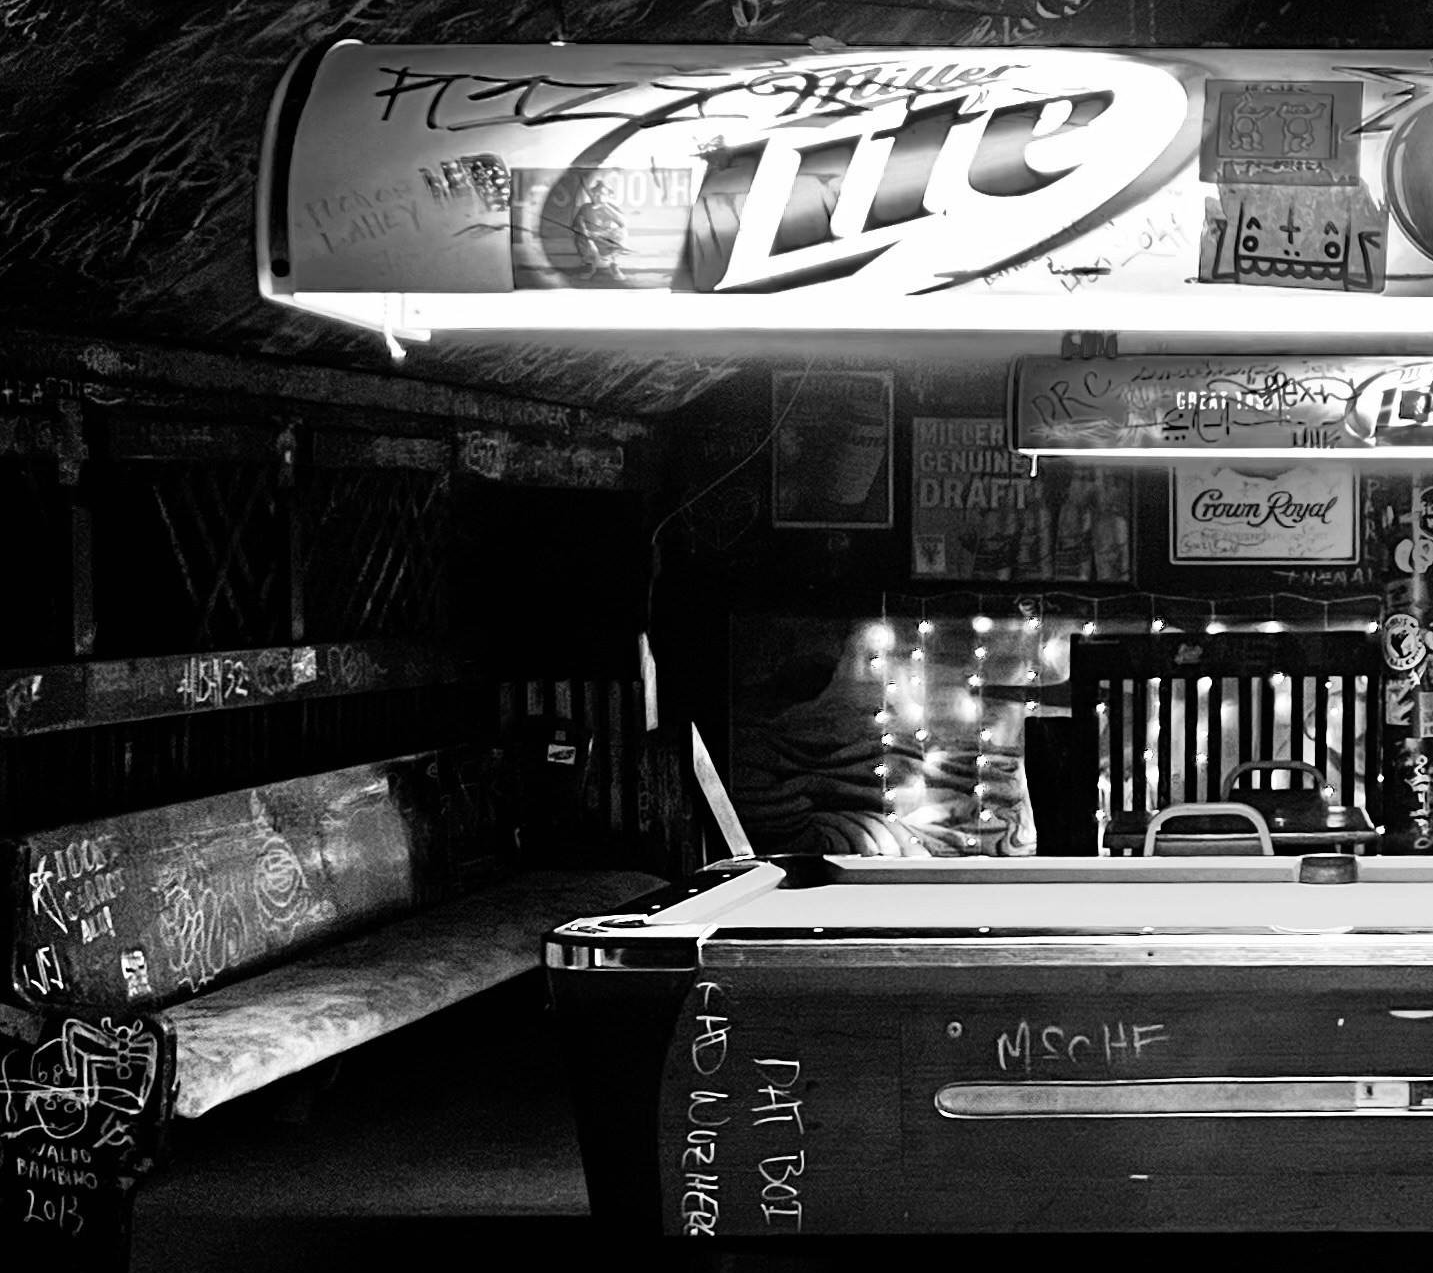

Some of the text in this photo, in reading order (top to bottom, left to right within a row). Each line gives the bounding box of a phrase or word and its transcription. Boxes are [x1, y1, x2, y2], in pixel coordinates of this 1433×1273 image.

[815, 60, 1032, 111] Miller
[918, 448, 1030, 476] GENUINE
[918, 477, 1028, 511] DRAFT
[1191, 488, 1262, 523] Crown
[1247, 491, 1340, 529] Royal
[999, 1020, 1170, 1072] MSCHF
[751, 1058, 805, 1135] DAT
[28, 1142, 92, 1164] WALDO
[16, 1156, 99, 1191] BAMBINO
